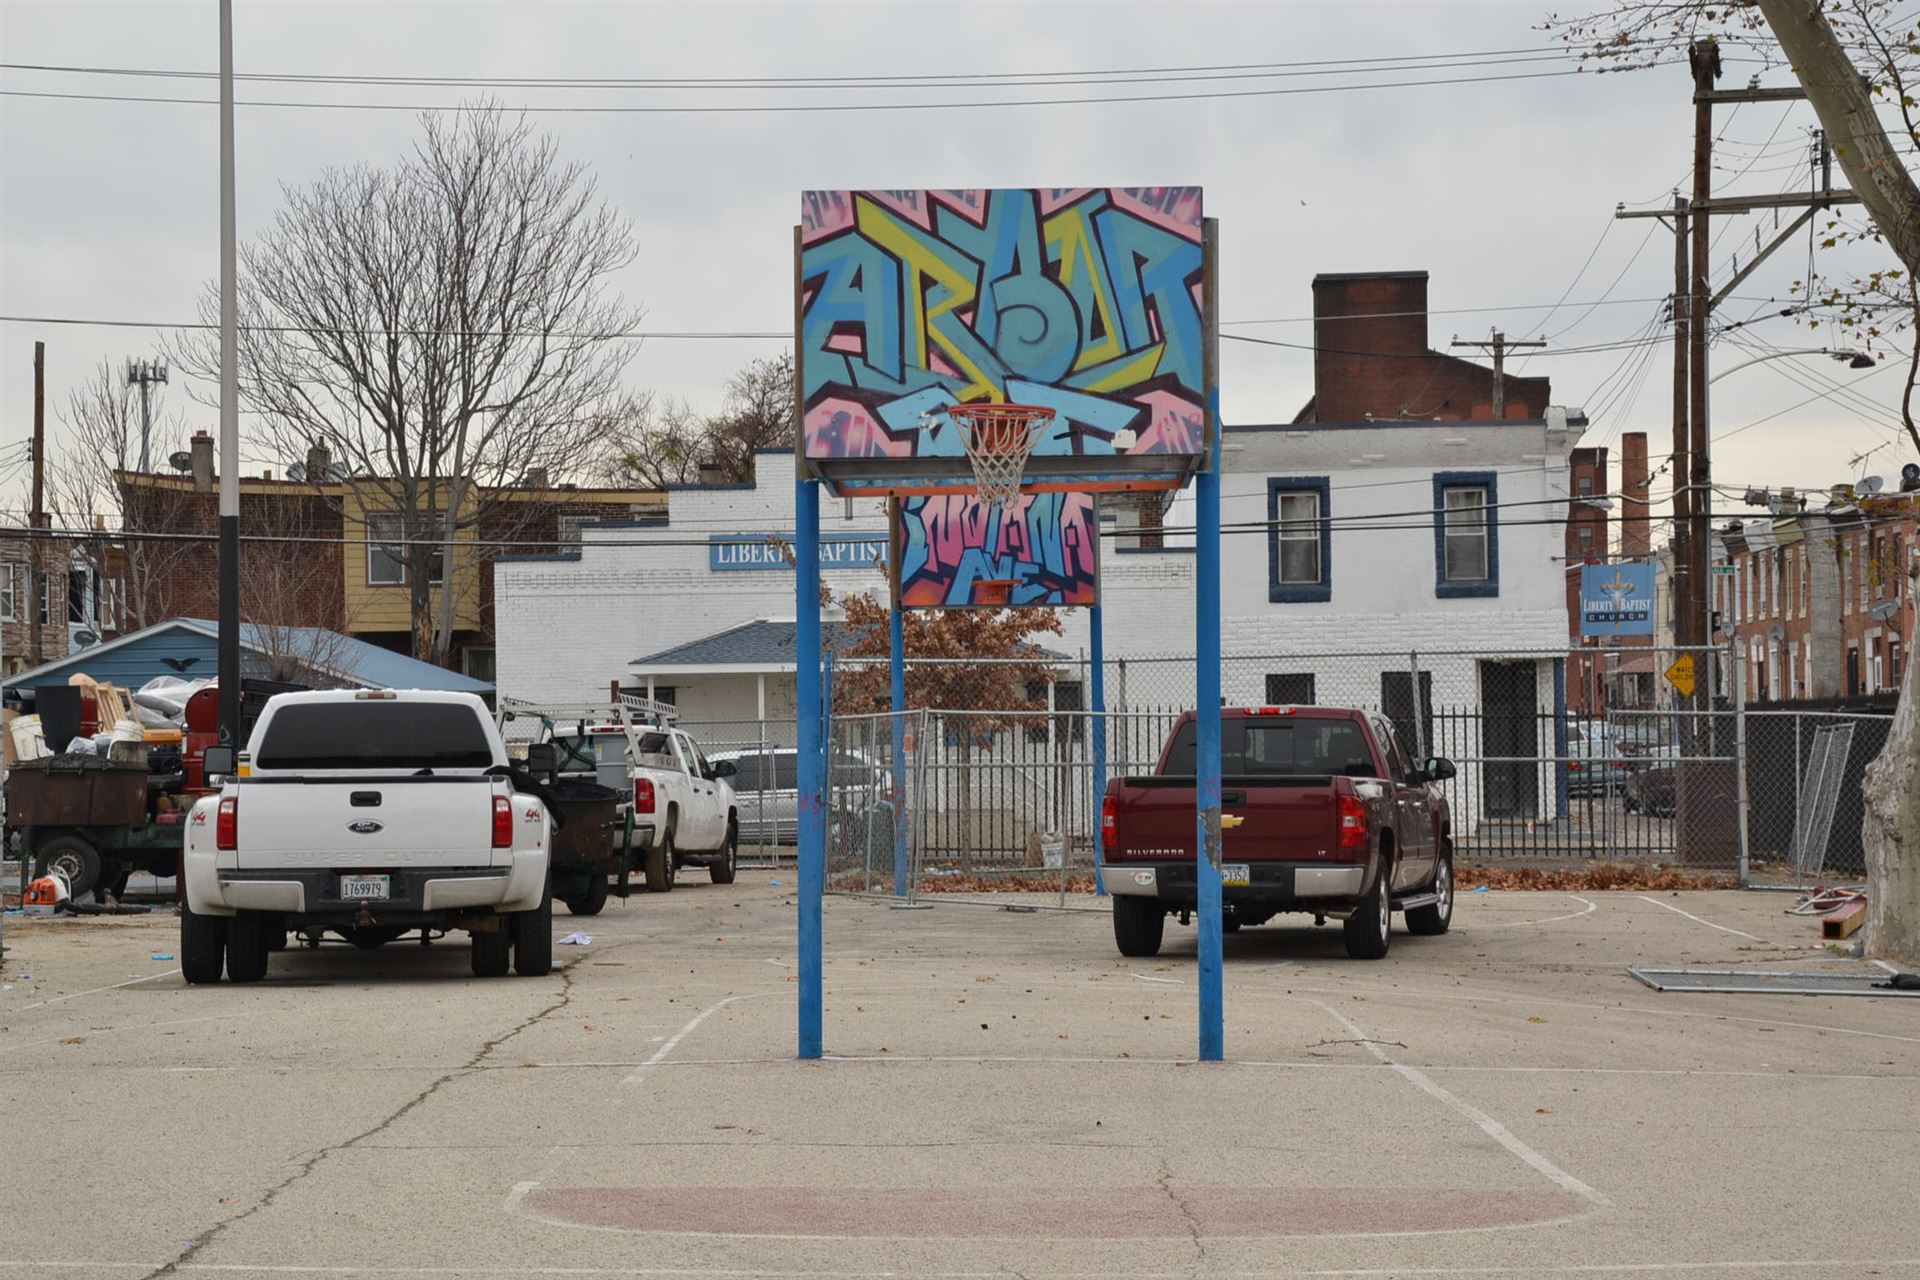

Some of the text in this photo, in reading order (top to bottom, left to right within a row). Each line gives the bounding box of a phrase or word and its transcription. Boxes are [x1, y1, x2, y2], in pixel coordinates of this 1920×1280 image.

[819, 541, 889, 562] APTIST
[1583, 598, 1652, 612] LIBERTY BAPTIST
[1589, 613, 1645, 621] CHURCH
[283, 850, 447, 864] SUPER DUTY
[344, 883, 382, 896] 1769979
